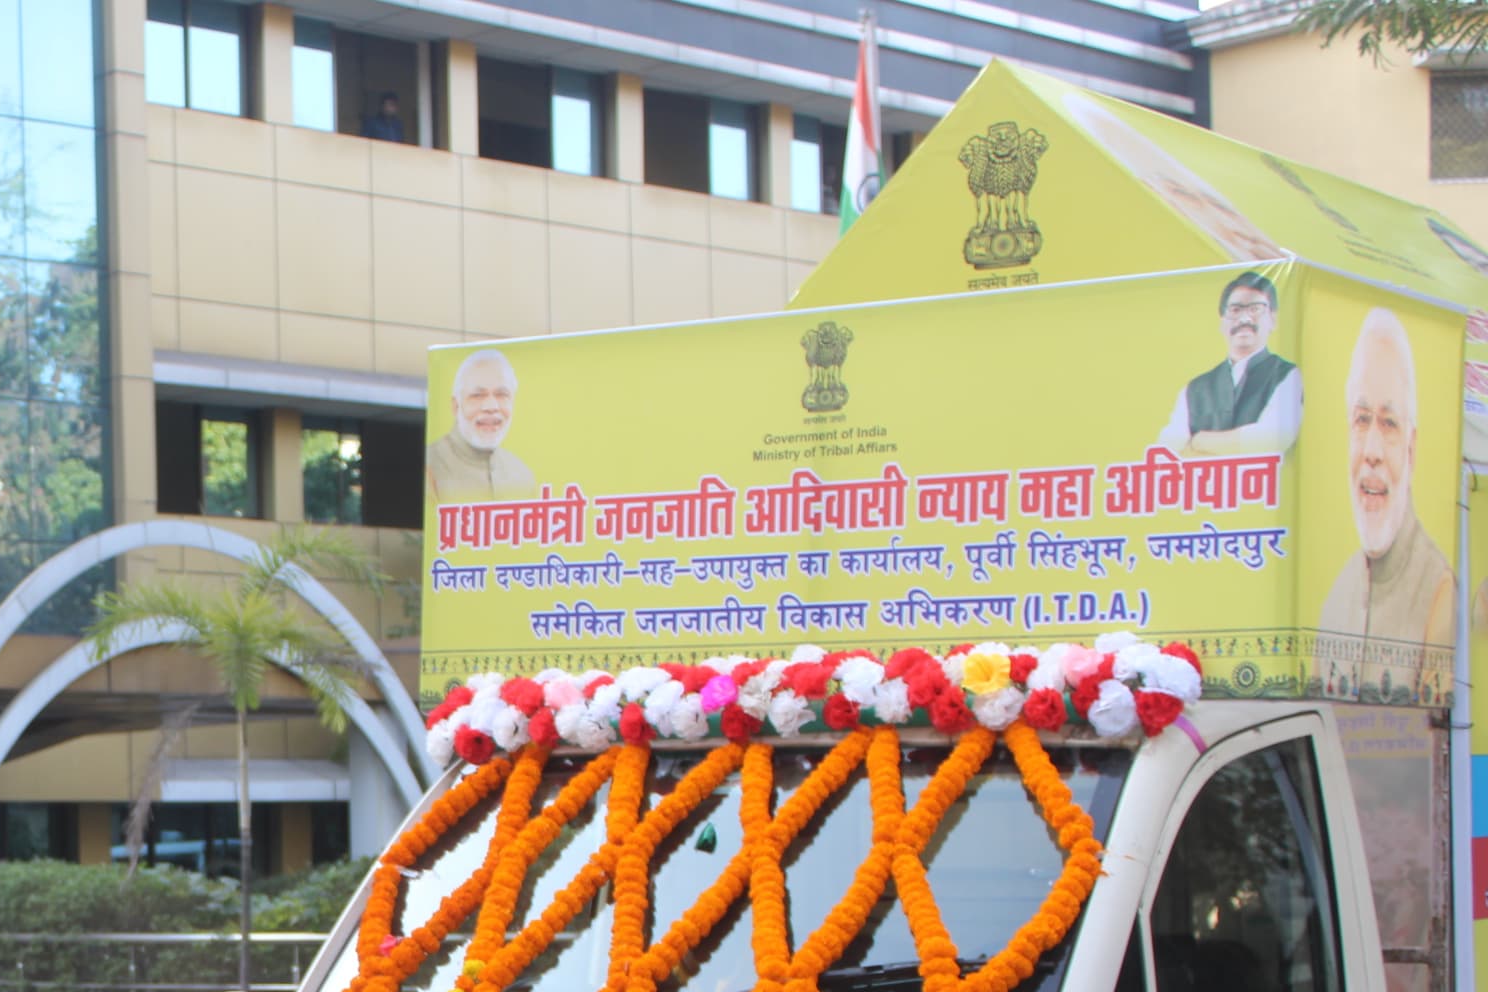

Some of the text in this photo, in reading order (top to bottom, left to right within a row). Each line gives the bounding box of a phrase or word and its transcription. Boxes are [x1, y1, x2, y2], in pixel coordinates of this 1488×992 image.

[752, 450, 801, 463] Ministry
[803, 445, 817, 459] of
[820, 443, 854, 457] Tribal
[763, 425, 888, 446] Government of India
[439, 447, 1281, 551] प्रधानमंत्री जनजाति आदिवासी न्याय महा अभियान
[431, 559, 487, 590] जिला
[798, 552, 831, 576] का
[839, 537, 954, 578] कार्यालय,
[965, 532, 1017, 580] पूर्वी
[1027, 532, 1136, 577] सिंहभूम,
[1147, 523, 1287, 569] जमशेदपुर
[530, 589, 1150, 637] समेकित जनजातीय विकास अभिकरण (I.T.D.A.)
